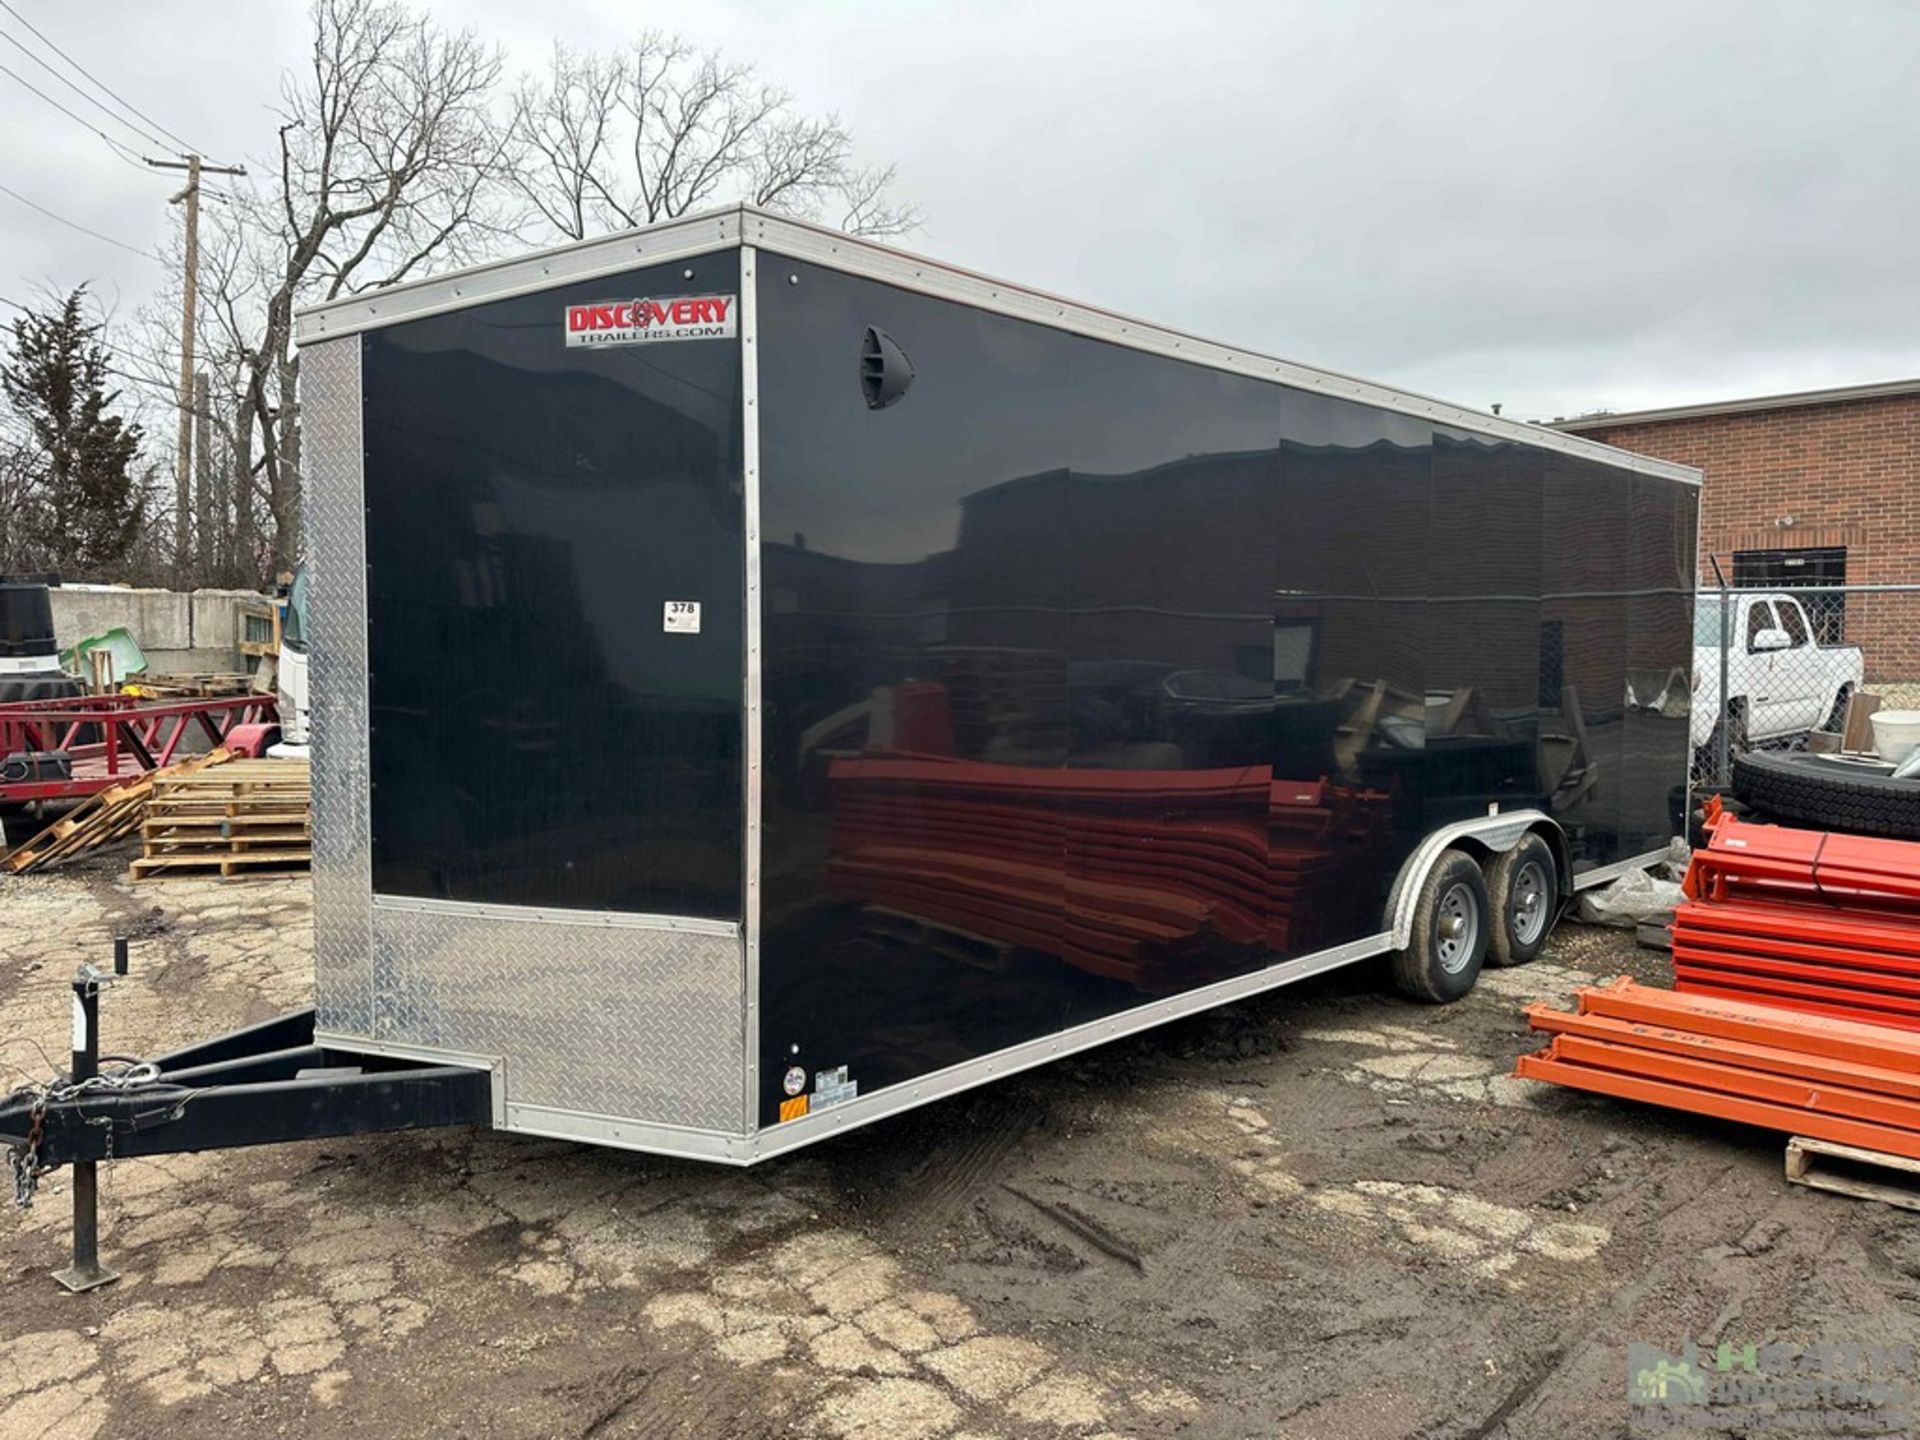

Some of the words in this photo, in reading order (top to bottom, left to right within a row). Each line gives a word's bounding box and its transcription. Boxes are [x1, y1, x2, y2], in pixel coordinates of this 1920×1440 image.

[569, 298, 732, 332] DISCOVERY
[579, 326, 725, 344] TRAILERS.COM
[671, 602, 695, 614] 378
